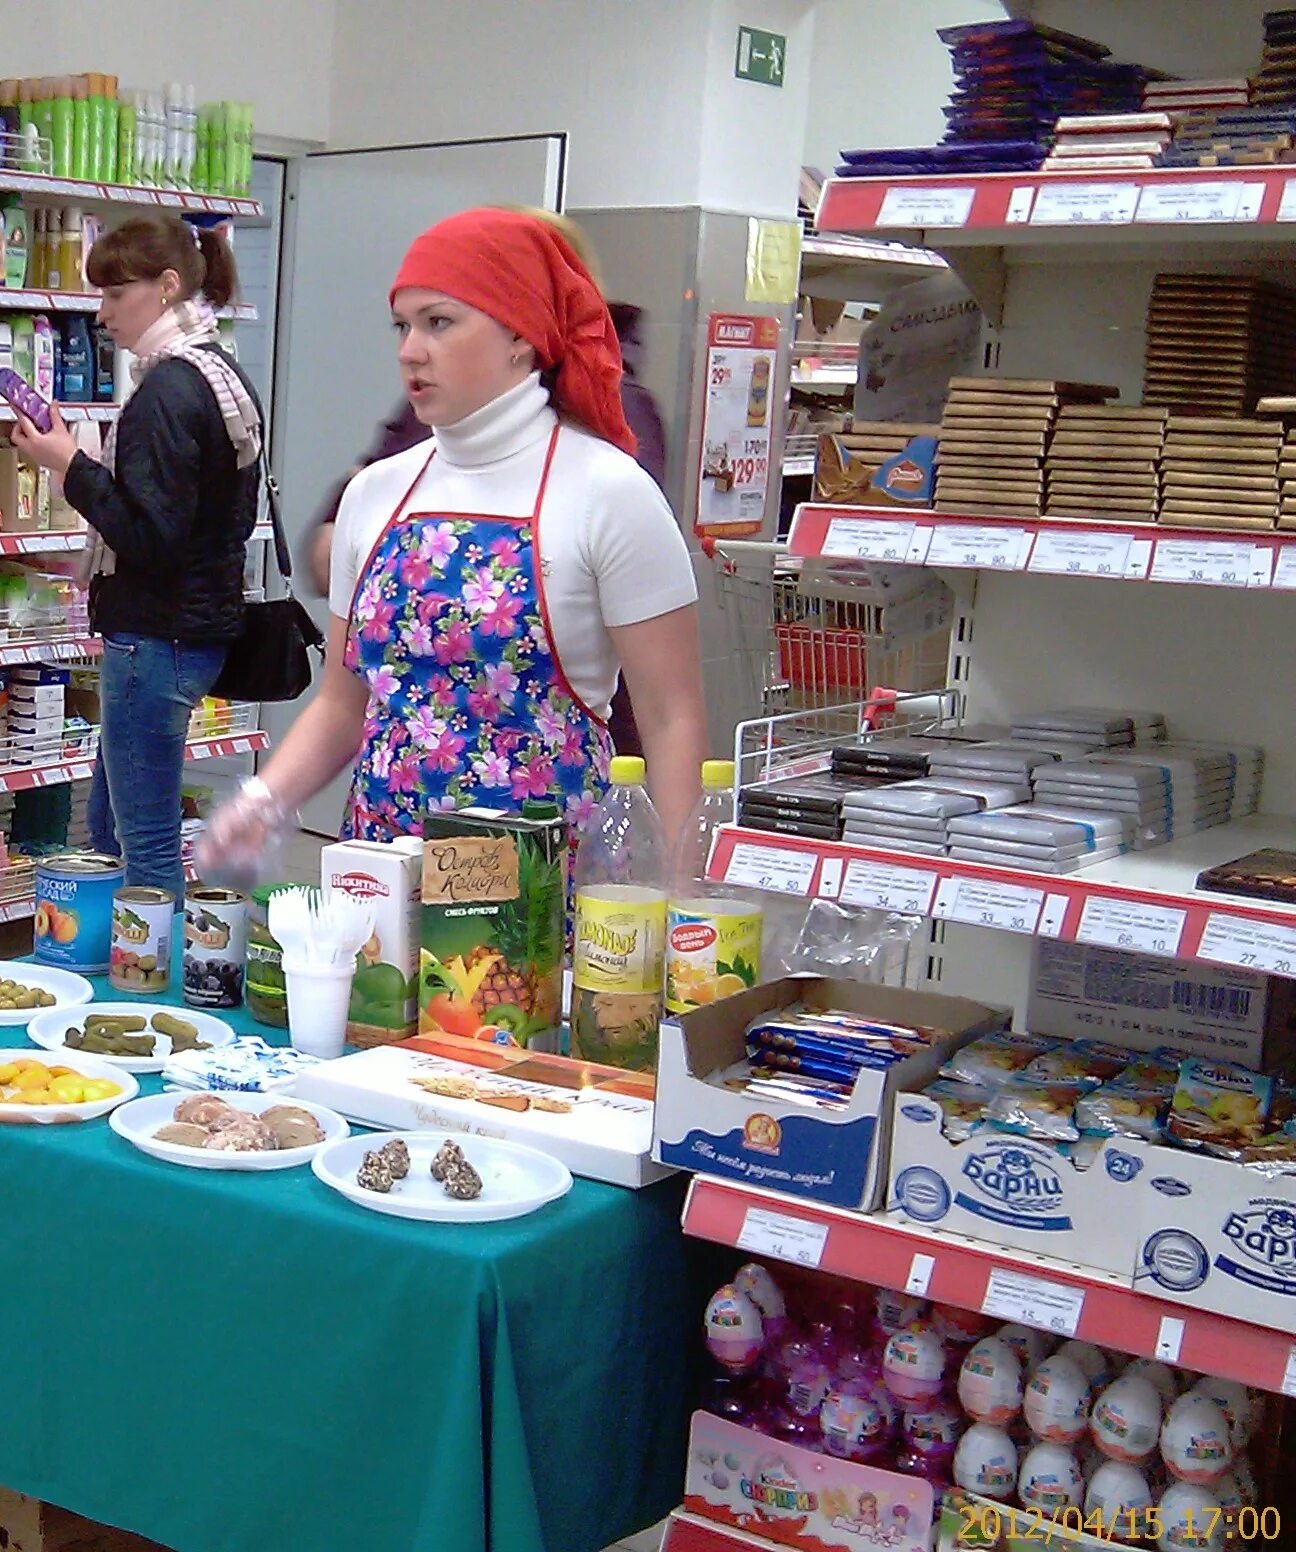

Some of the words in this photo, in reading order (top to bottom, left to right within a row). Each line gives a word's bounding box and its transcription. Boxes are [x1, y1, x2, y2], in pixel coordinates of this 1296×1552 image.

[432, 844, 504, 876] Остров
[758, 876, 771, 887] 47
[876, 895, 889, 906] 34
[904, 899, 919, 911] 20
[1010, 917, 1025, 929] 30
[1152, 939, 1166, 951] 10
[1239, 953, 1256, 964] 27
[1274, 960, 1291, 972] 20
[1112, 1159, 1130, 1175] 24
[961, 1152, 1064, 1200] Барни
[1221, 1211, 1296, 1262] Бар
[1021, 1309, 1035, 1320] 15
